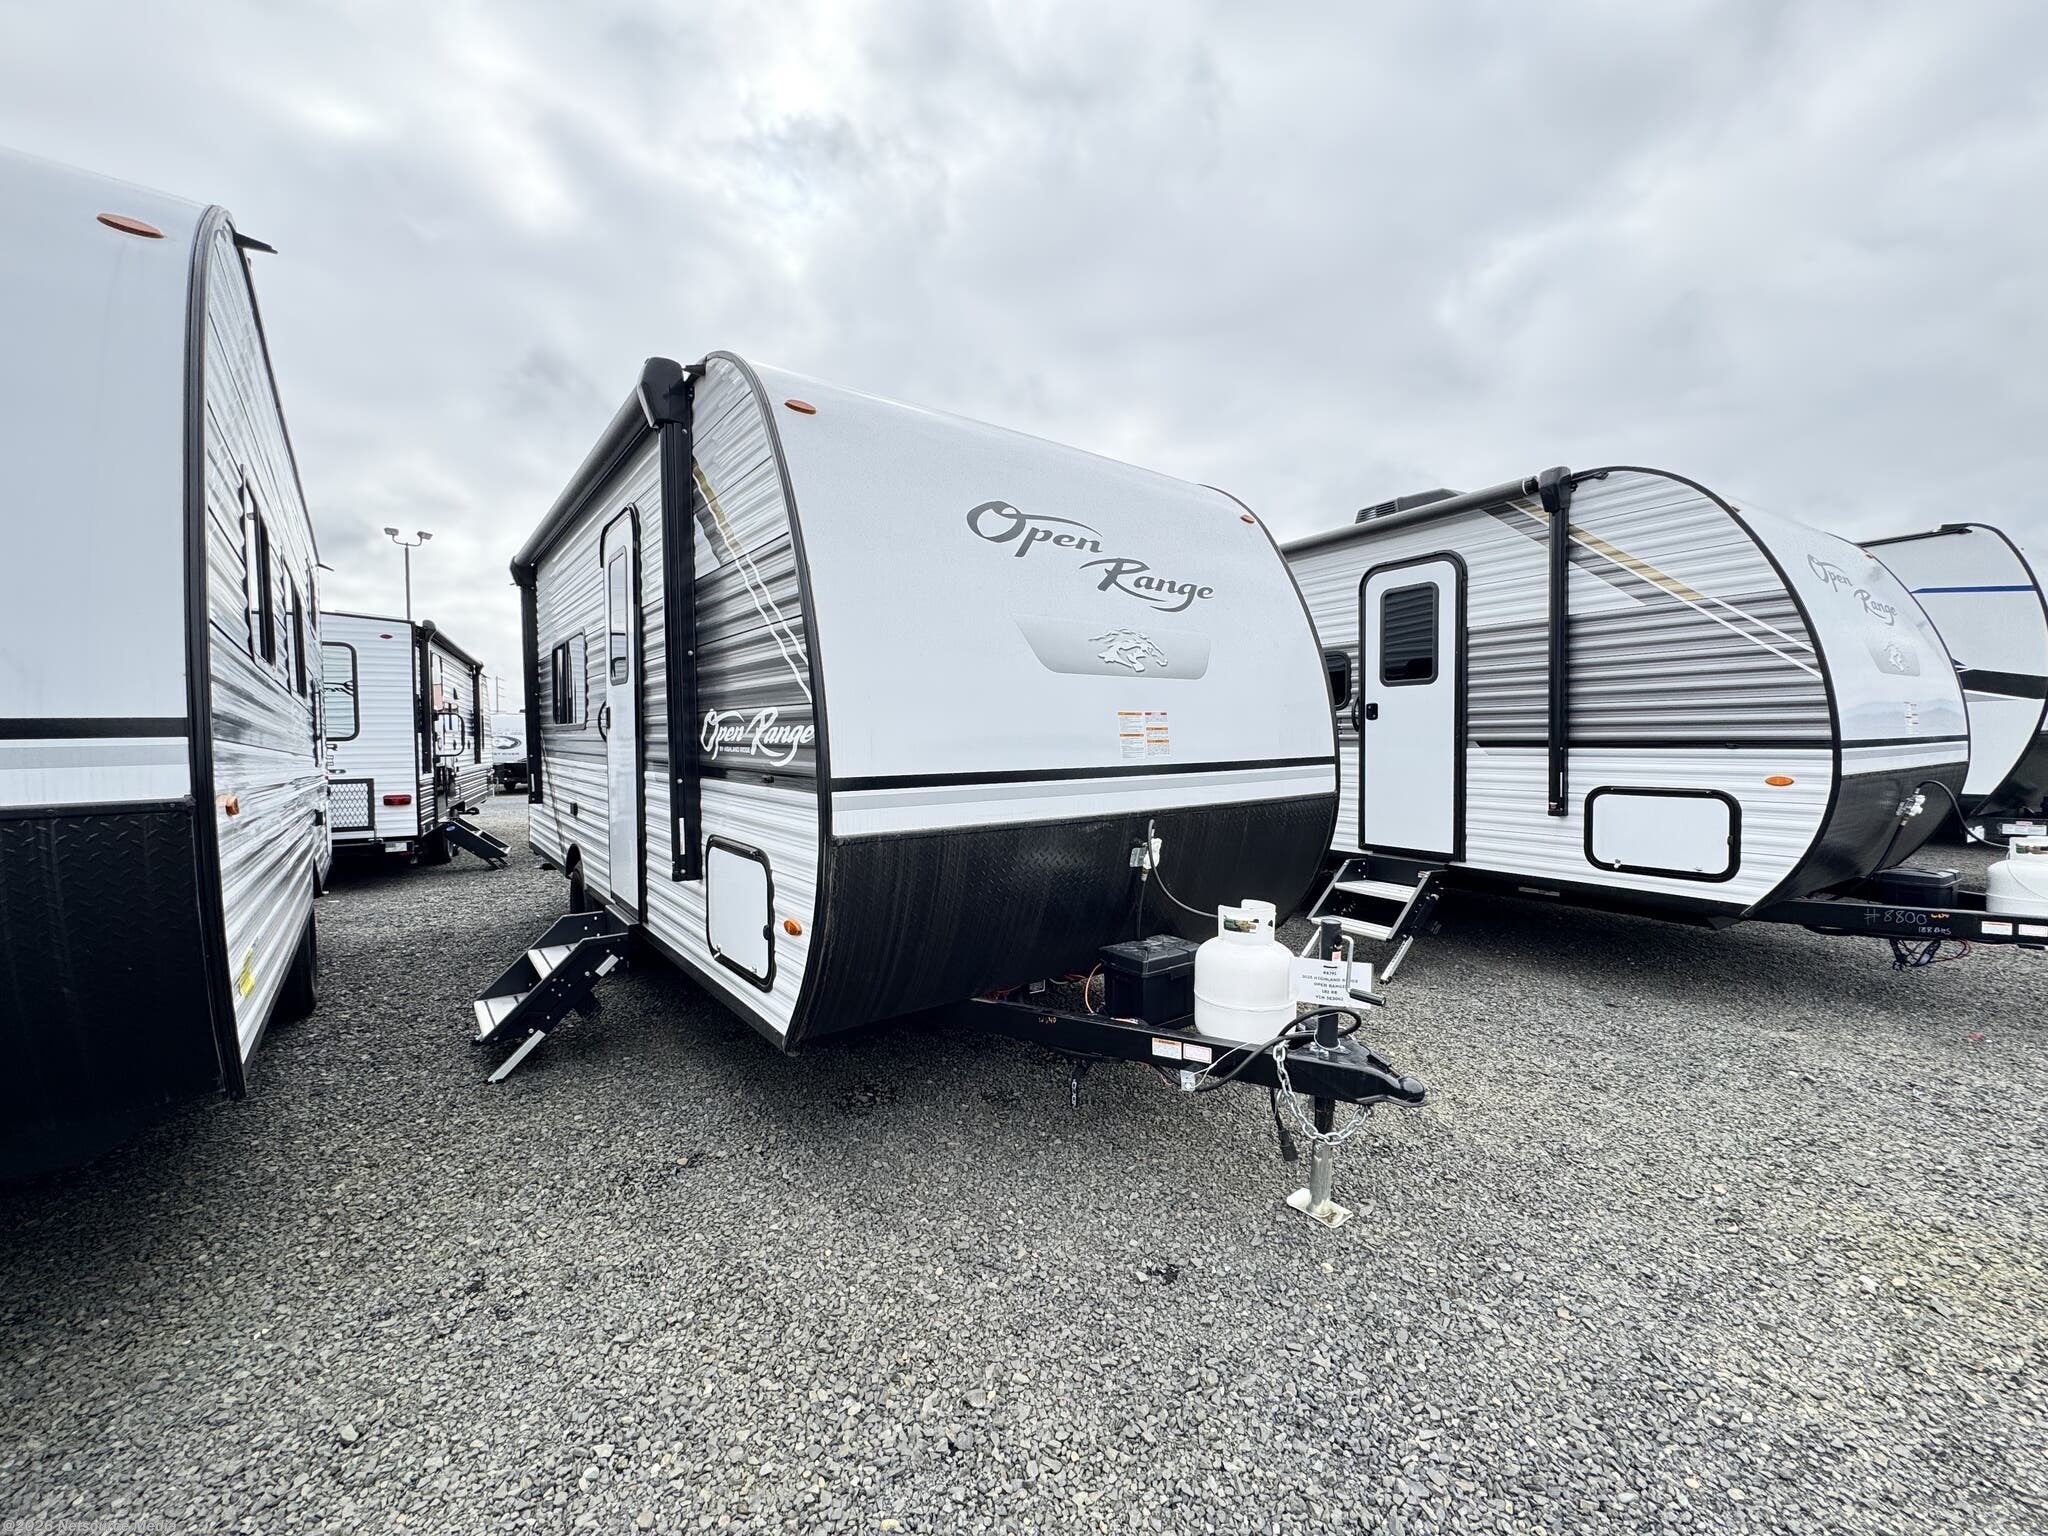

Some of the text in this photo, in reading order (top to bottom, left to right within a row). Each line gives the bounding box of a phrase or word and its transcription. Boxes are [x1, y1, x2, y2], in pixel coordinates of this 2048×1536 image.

[966, 500, 1217, 613] Open Range
[1807, 554, 1898, 626] Open Range
[700, 706, 815, 767] Open Range
